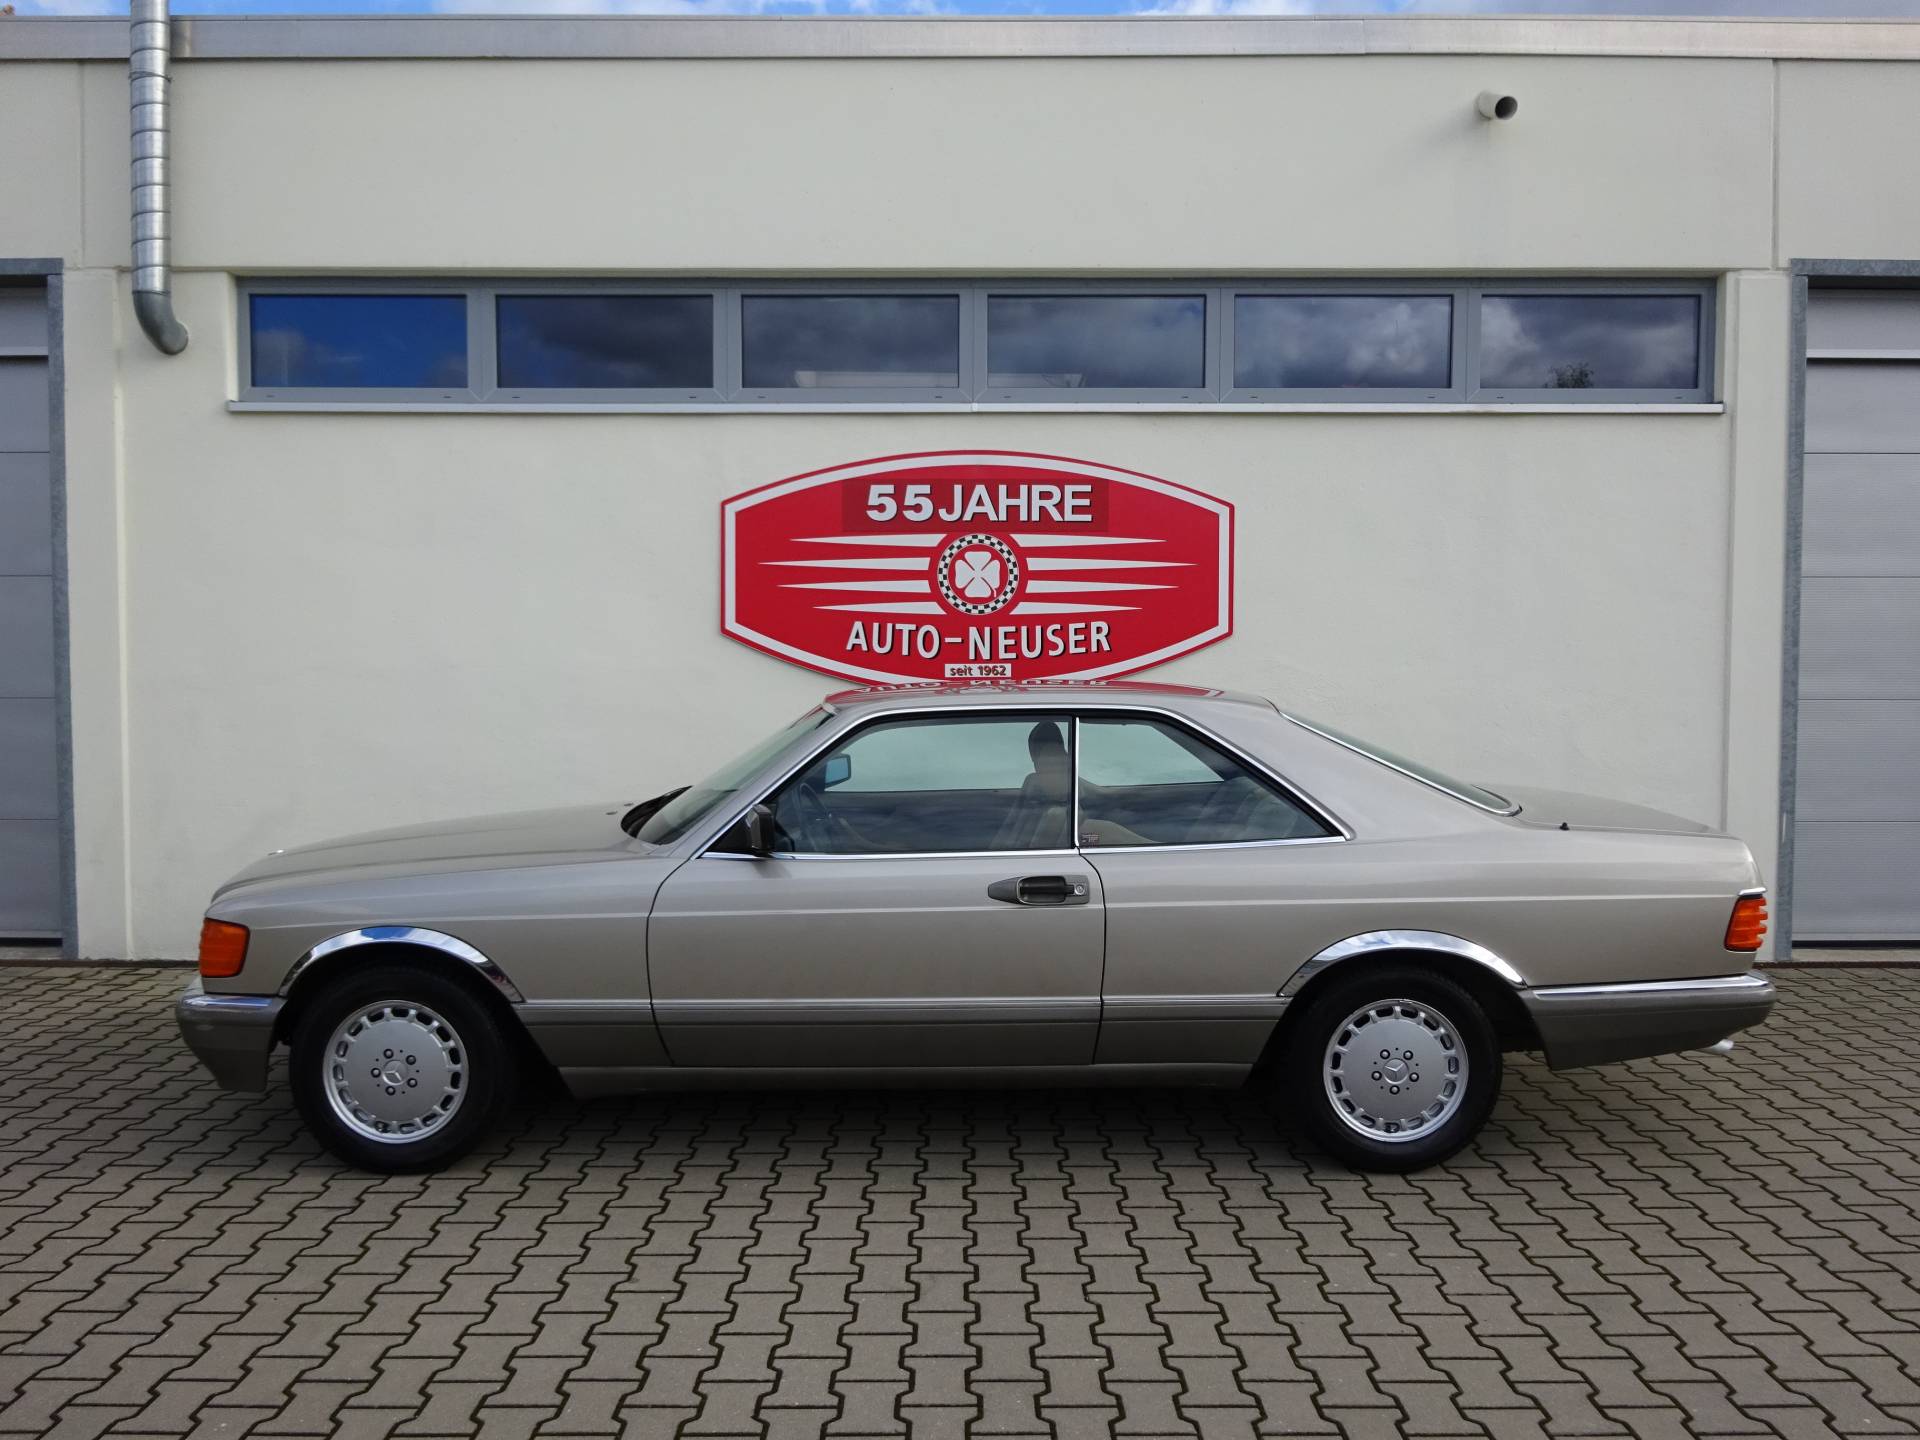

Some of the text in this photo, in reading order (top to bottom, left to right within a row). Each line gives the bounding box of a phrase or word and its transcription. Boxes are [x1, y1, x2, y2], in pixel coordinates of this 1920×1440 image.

[846, 620, 1111, 661] AUTO-NEUSER
[949, 664, 1007, 677] seit 1962
